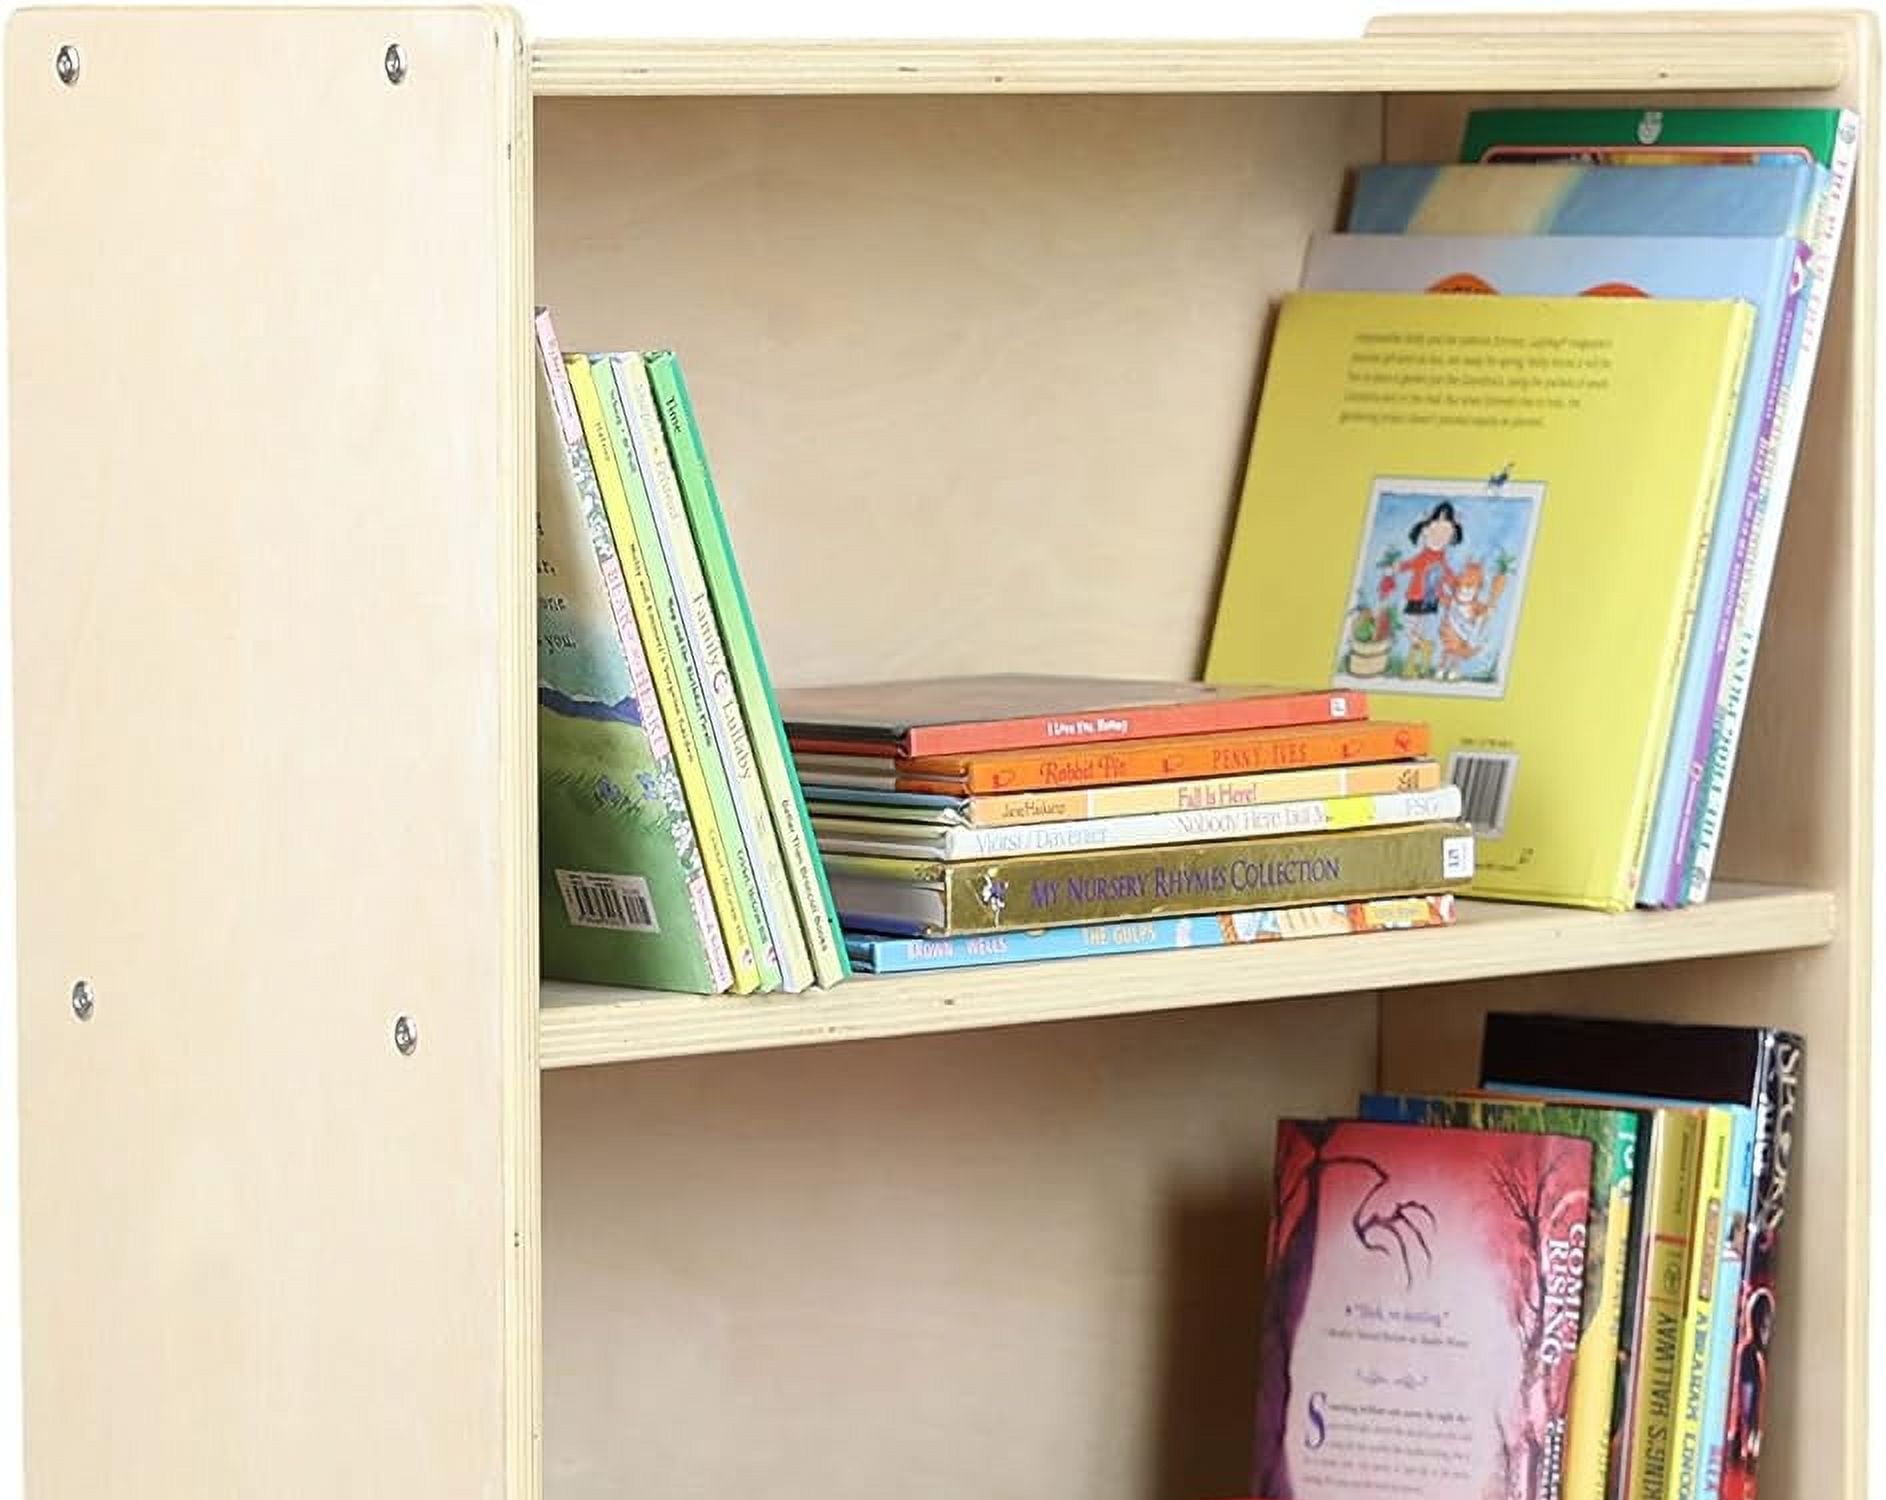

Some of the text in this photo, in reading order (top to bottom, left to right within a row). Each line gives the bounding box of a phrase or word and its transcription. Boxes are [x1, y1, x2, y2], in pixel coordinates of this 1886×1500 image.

[722, 700, 751, 785] Lullaby
[1039, 752, 1094, 784] Rabbit
[1211, 743, 1308, 770] PENNY IVES
[1030, 856, 1341, 909] MY NURSERY RHYMES COLLECTION
[1539, 1238, 1571, 1367] RISING
[1562, 1221, 1587, 1351] COMET
[1647, 1310, 1681, 1418] HALLWAY
